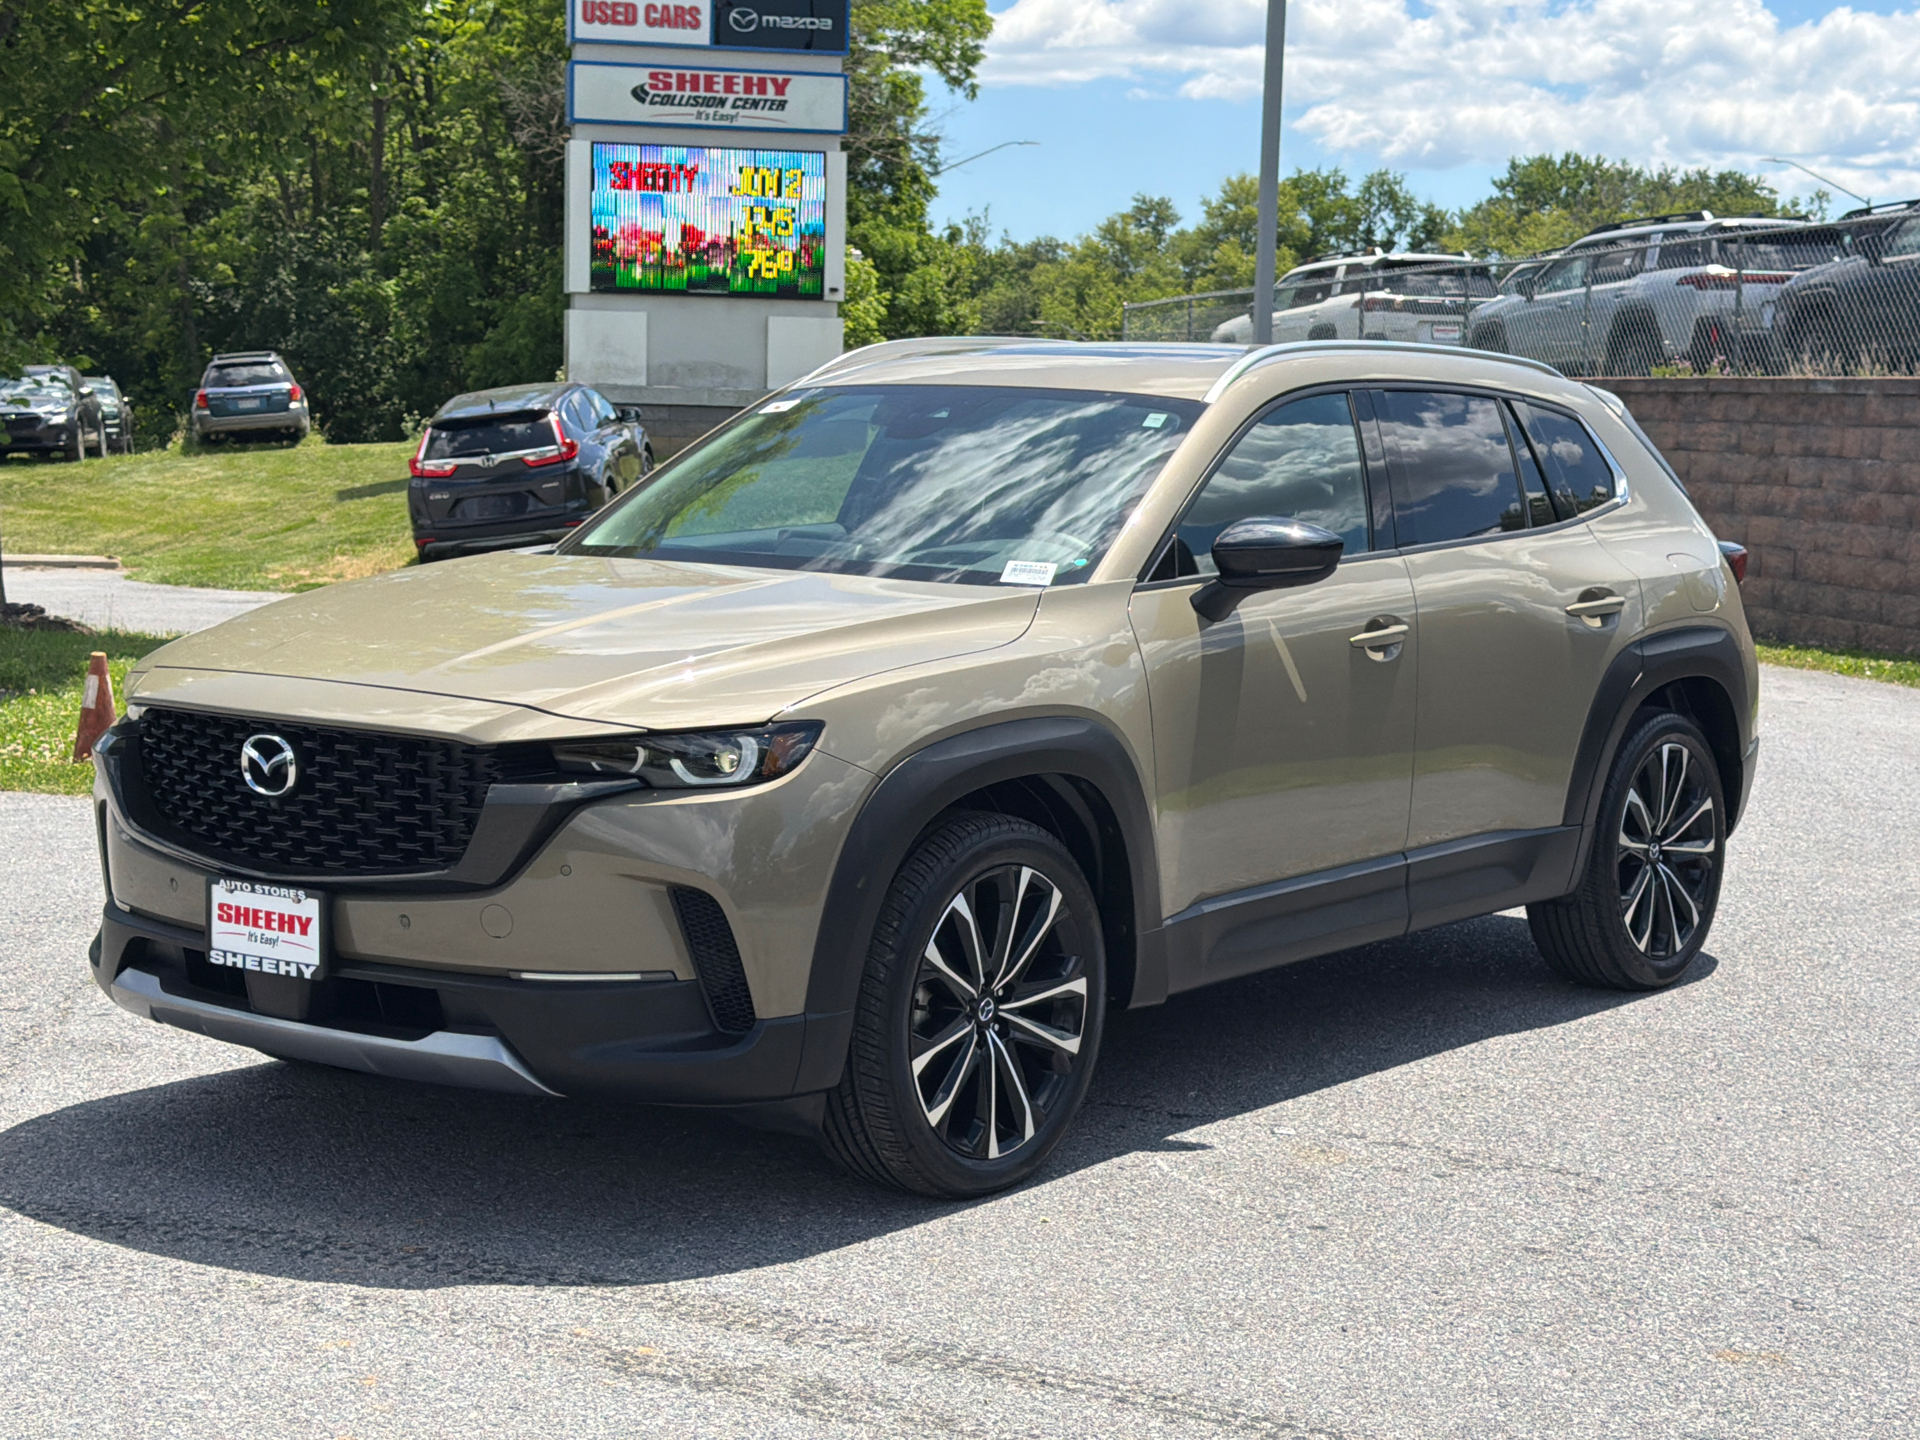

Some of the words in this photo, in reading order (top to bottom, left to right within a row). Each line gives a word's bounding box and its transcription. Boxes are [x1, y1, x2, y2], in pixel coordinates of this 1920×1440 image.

[582, 1, 638, 26] USED
[645, 3, 702, 30] CARS
[761, 14, 833, 30] mazda
[648, 71, 792, 96] SHEEHY
[649, 93, 728, 110] COLLISION
[731, 97, 788, 111] CENTER
[695, 110, 709, 121] It's
[712, 110, 740, 123] Easy!
[610, 161, 699, 192] SHEEHY
[219, 879, 251, 892] AUTO
[254, 885, 306, 900] STORES
[217, 902, 313, 936] SHEEHY
[247, 931, 258, 943] It's
[260, 933, 280, 948] Easy!
[210, 950, 317, 979] SHEEHY
